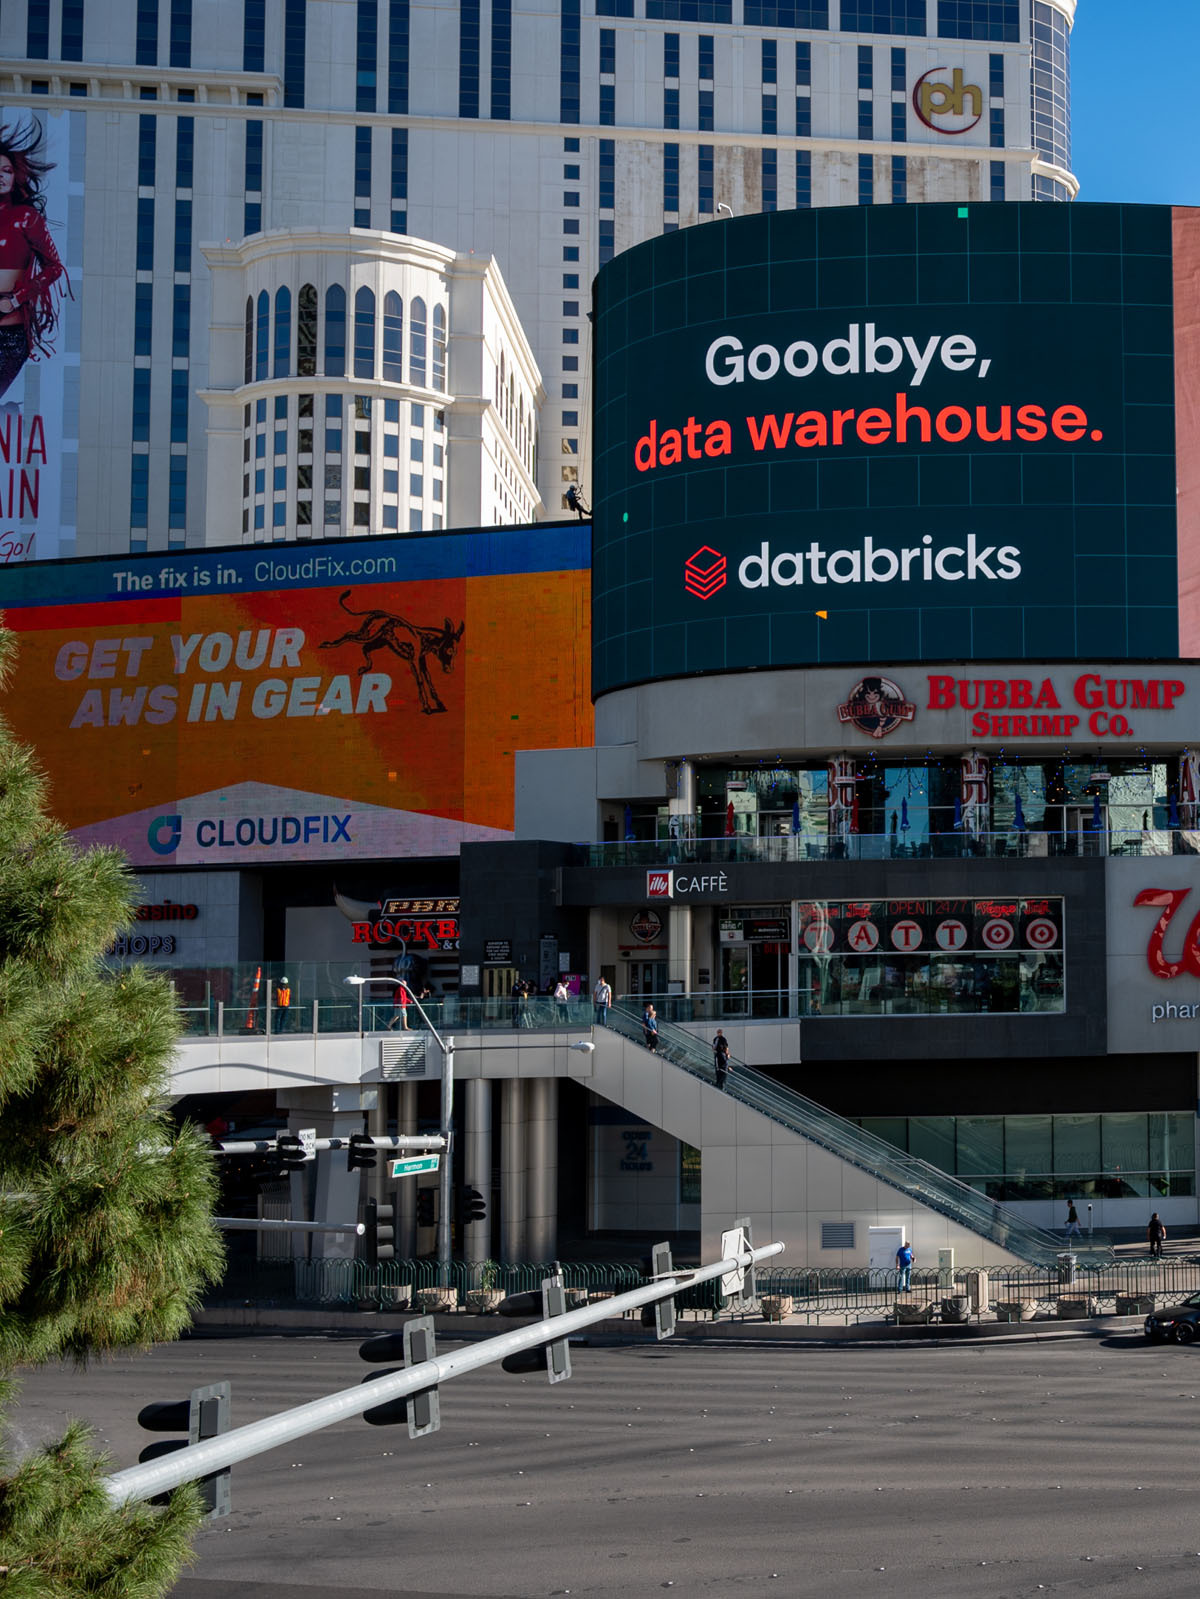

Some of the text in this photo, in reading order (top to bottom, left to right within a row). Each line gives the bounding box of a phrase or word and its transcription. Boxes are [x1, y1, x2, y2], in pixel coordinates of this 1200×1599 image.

[705, 323, 992, 386] Goodbye,
[634, 392, 1103, 472] data warehouse.
[0, 468, 39, 519] IN
[113, 556, 396, 592] The fix is in. CloudFix.com
[738, 533, 1021, 589] databricks
[54, 627, 306, 682] GET YOUR
[69, 673, 393, 729] AWS IN GEAR
[927, 674, 1186, 710] BUBBA GUMP
[972, 711, 1080, 737] SHRIMP
[197, 814, 352, 848] CLOUDFIX
[650, 871, 728, 894] illy CAFFÈ
[127, 898, 198, 921] asino
[389, 900, 459, 913] PBR
[889, 901, 925, 914] OPEN
[352, 919, 459, 949] ROCKB
[626, 1142, 648, 1160] 24
